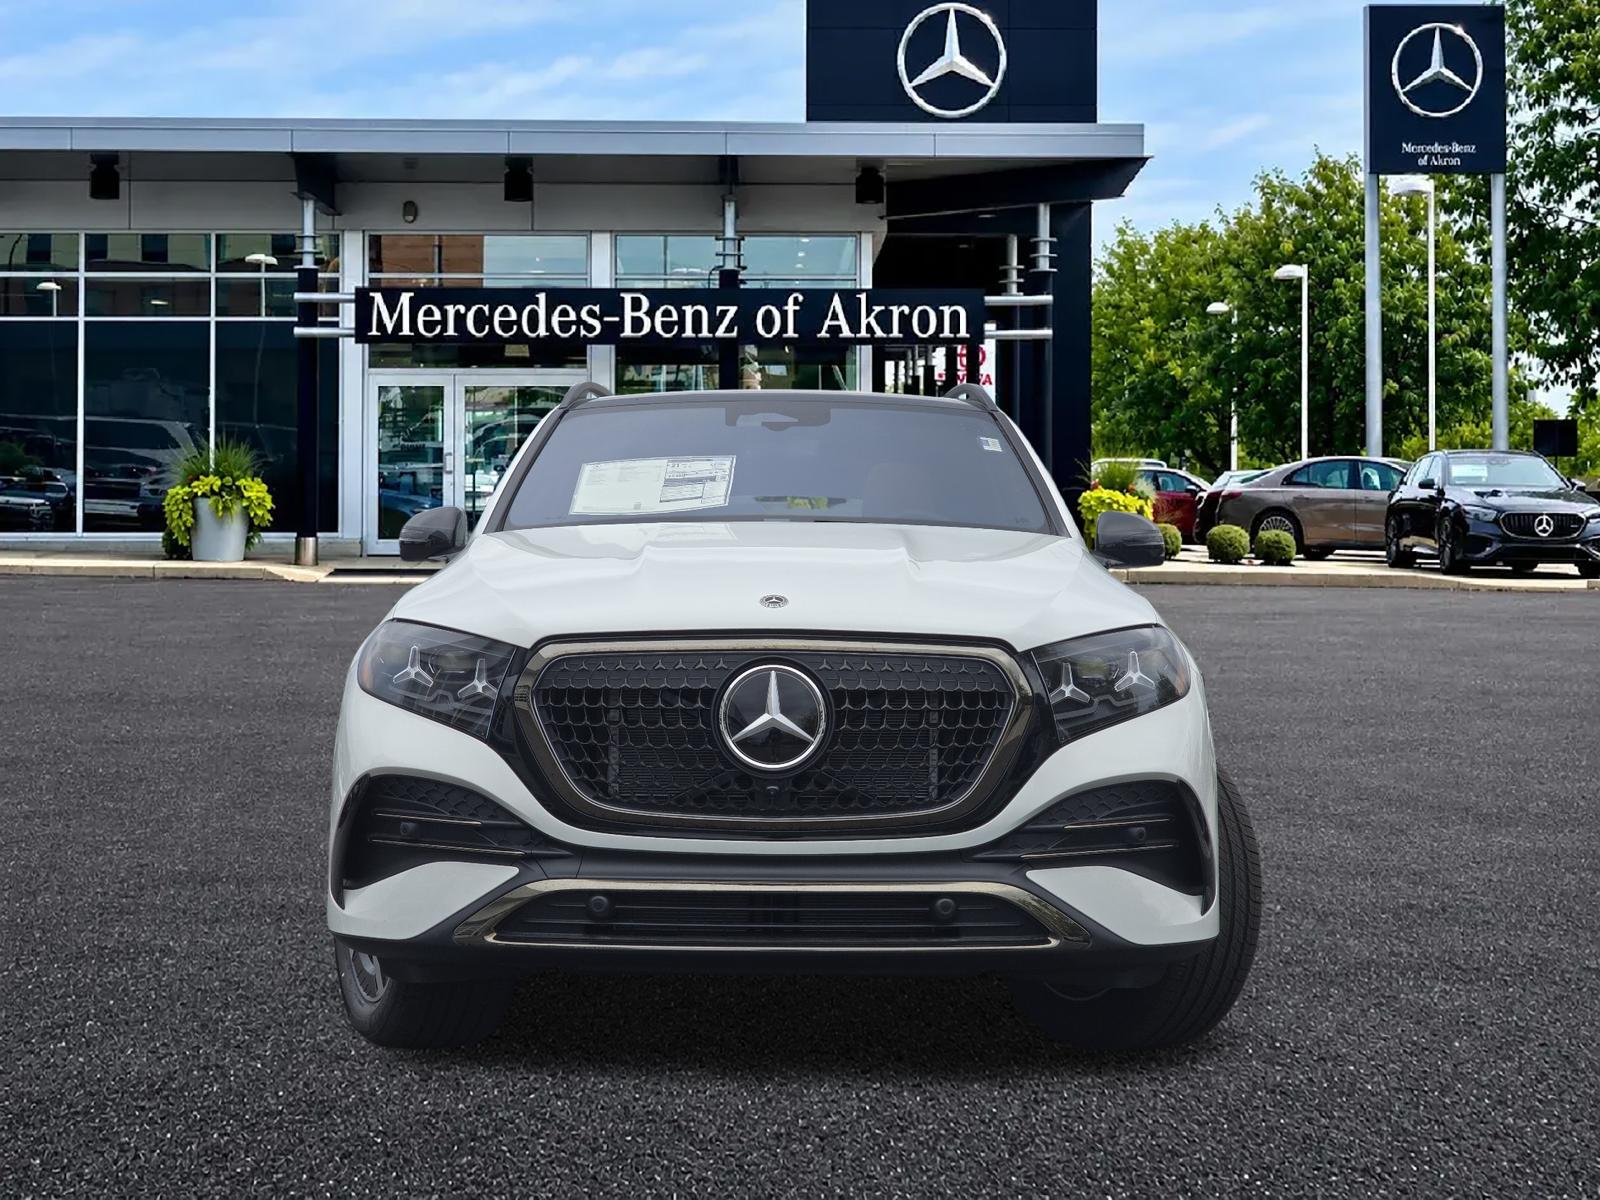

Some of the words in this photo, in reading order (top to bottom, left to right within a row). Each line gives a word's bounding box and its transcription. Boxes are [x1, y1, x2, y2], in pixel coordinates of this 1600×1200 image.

[1401, 141, 1477, 154] Mercedes-Benz
[1417, 154, 1428, 166] of
[1430, 154, 1461, 166] Akron
[367, 292, 738, 338] Mercedes-Benz
[755, 292, 804, 338] of
[816, 292, 970, 338] Akron
